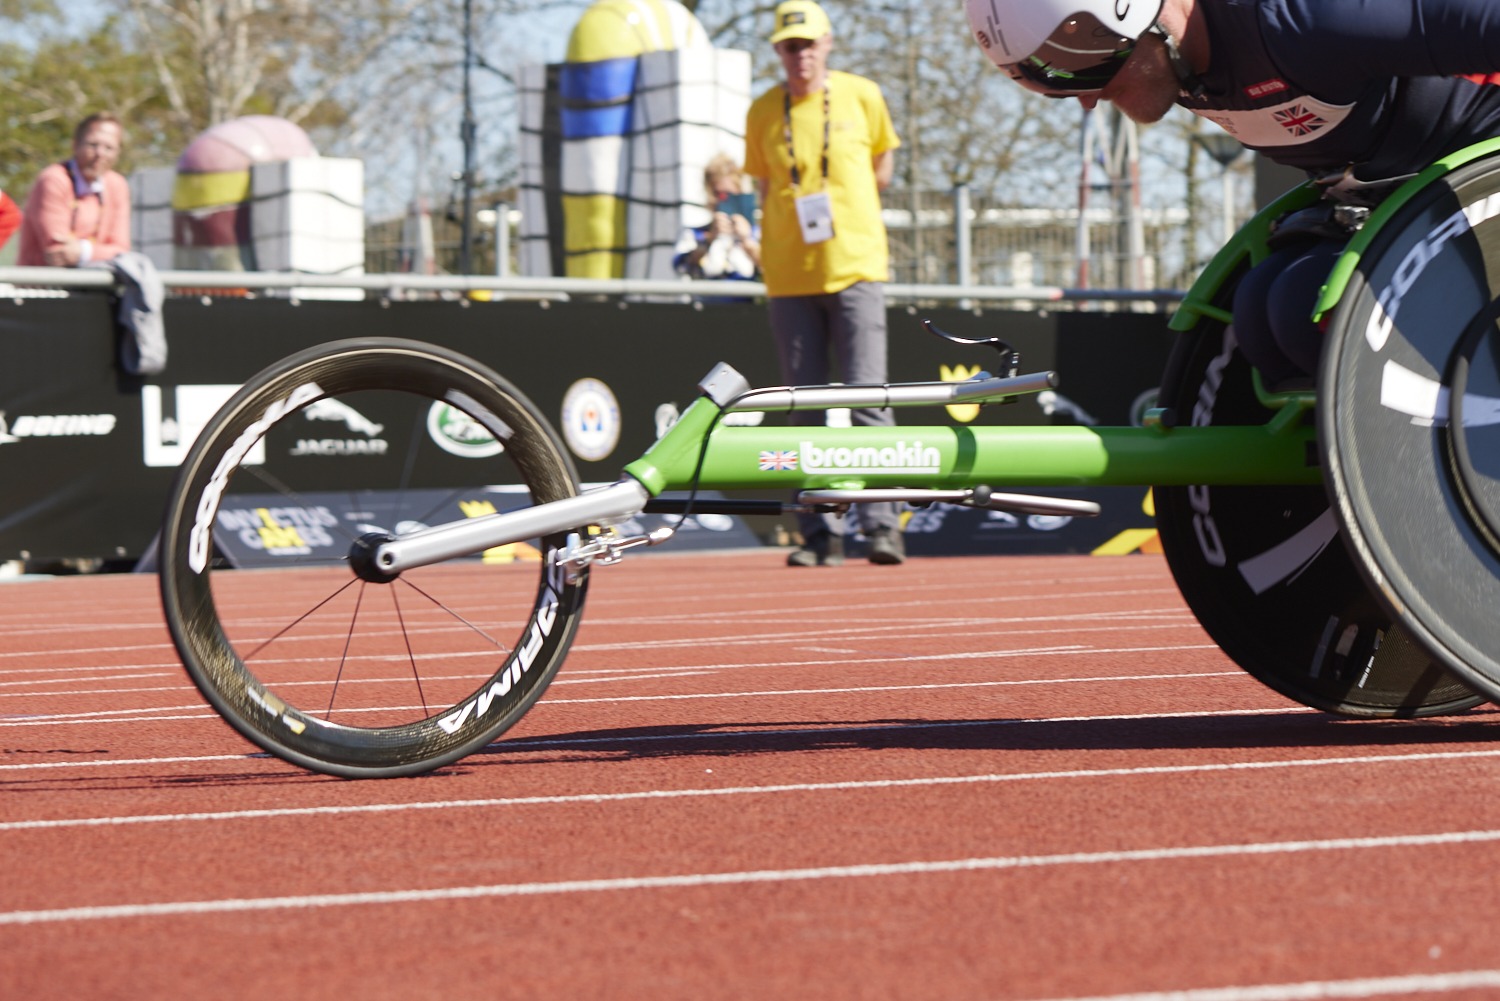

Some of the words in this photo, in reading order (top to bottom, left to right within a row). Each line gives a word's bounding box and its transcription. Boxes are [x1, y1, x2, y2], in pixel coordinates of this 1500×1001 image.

[11, 414, 117, 437] BOEING
[799, 440, 941, 475] bromakin
[188, 381, 325, 575] CORIMA
[216, 506, 338, 532] INVICTUS
